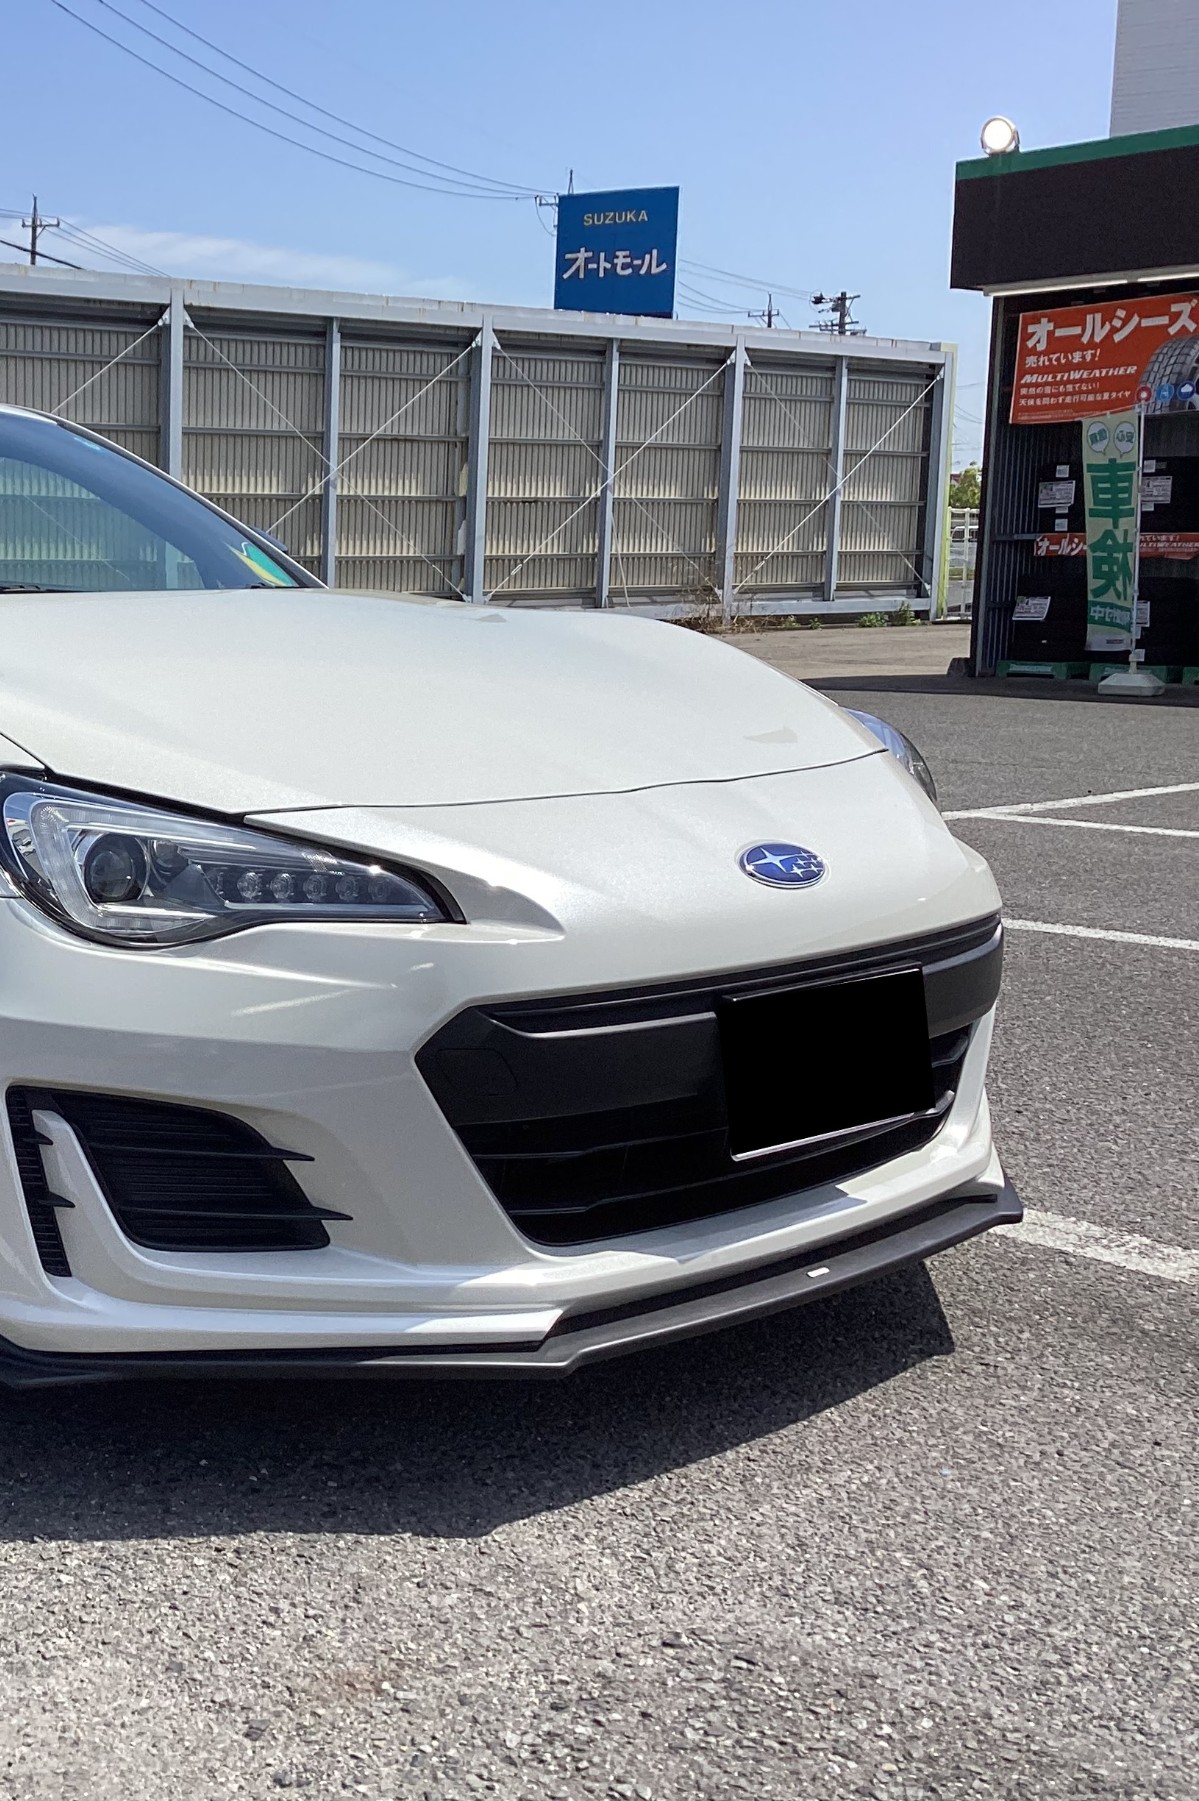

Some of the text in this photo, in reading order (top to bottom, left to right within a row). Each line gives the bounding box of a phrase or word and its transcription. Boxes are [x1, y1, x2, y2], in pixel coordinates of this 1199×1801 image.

[583, 209, 649, 227] SUZUKA
[562, 247, 668, 280] オートモール
[1025, 298, 1199, 352] オールシーズ
